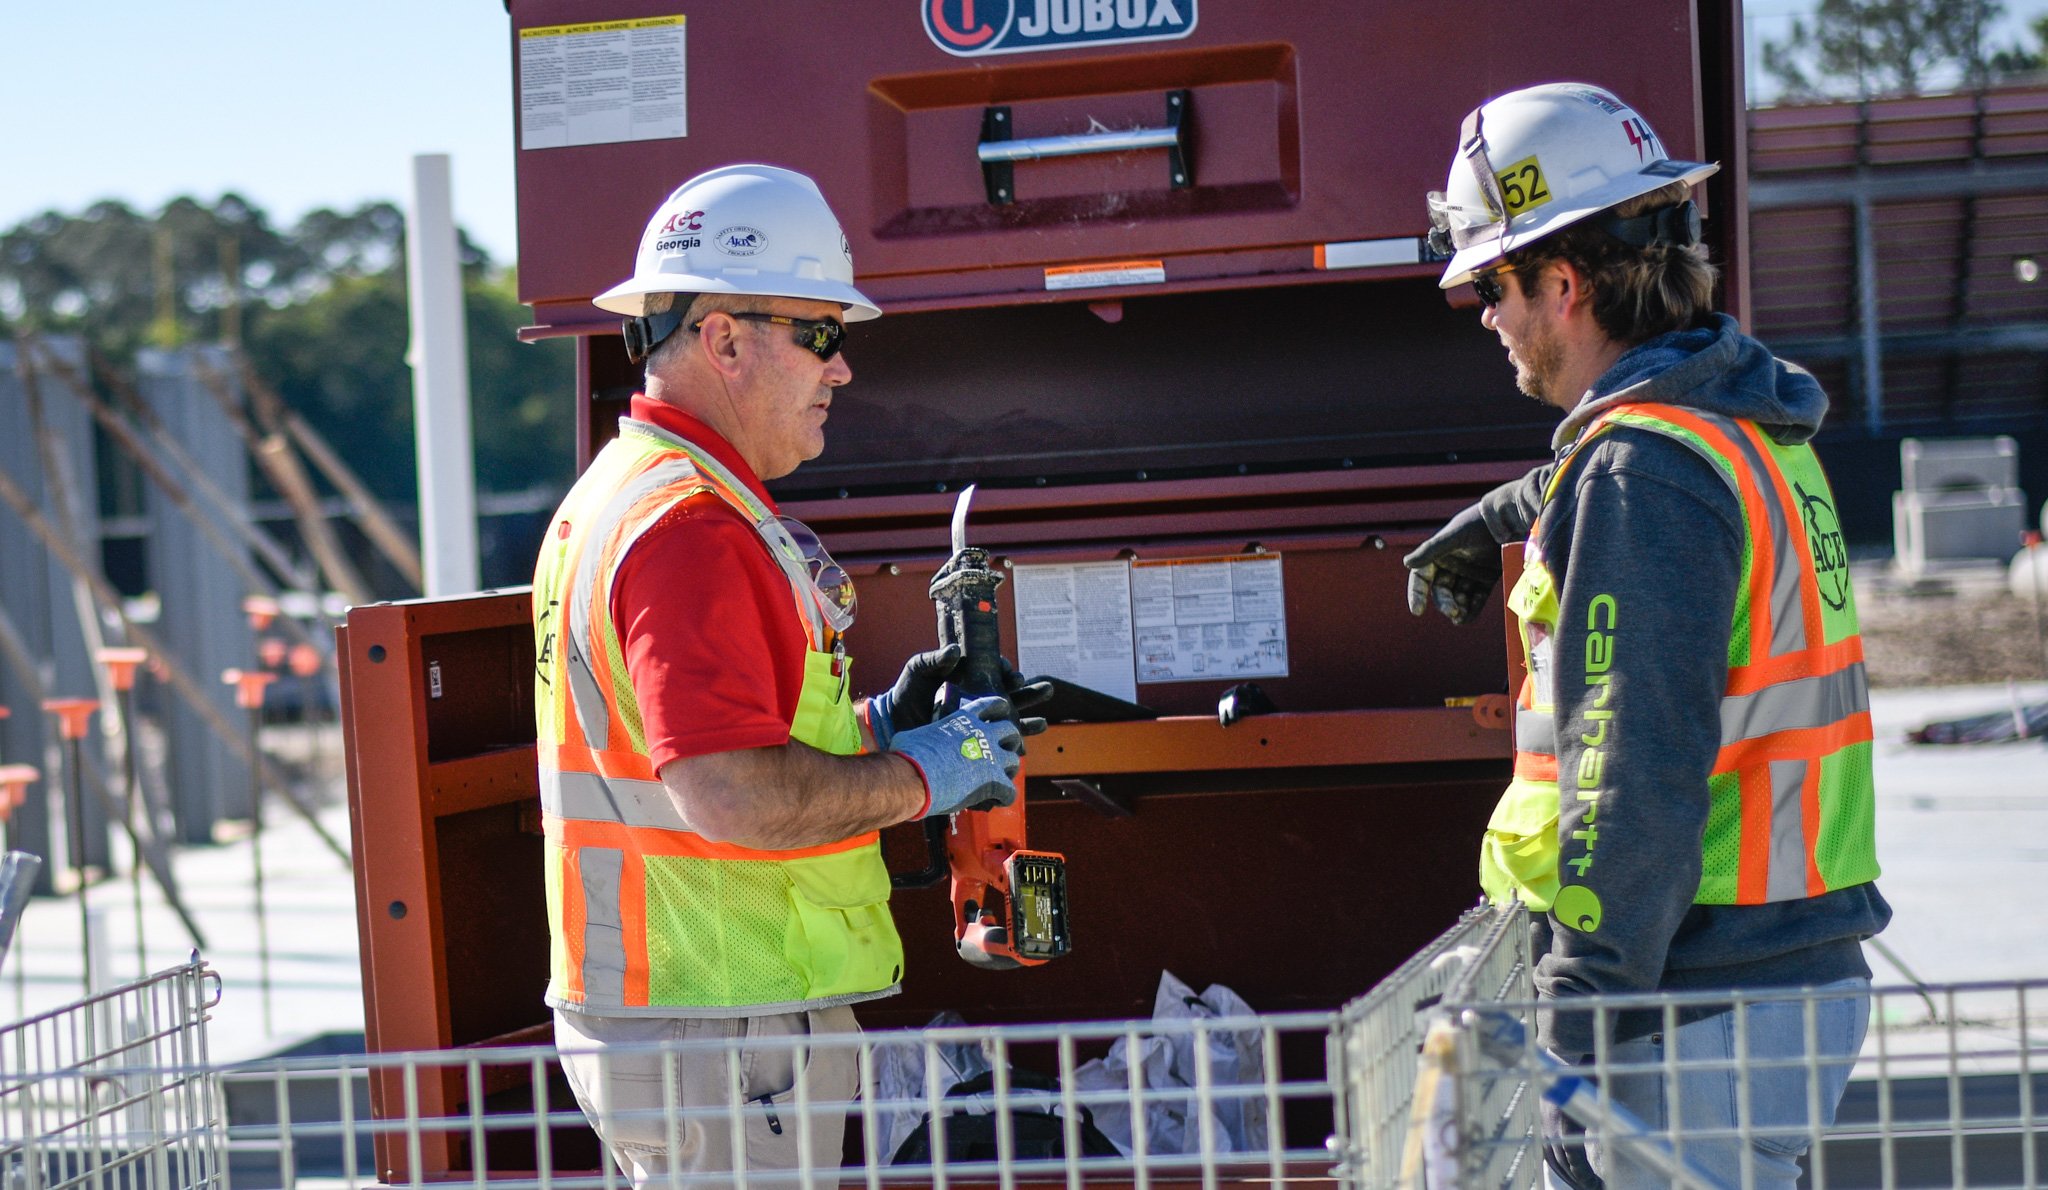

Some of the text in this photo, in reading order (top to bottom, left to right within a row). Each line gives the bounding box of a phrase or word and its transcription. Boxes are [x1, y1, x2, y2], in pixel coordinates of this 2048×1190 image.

[660, 210, 705, 234] AGC
[656, 237, 701, 251] Georgia
[1812, 531, 1846, 574] ACE
[963, 742, 978, 758] A4
